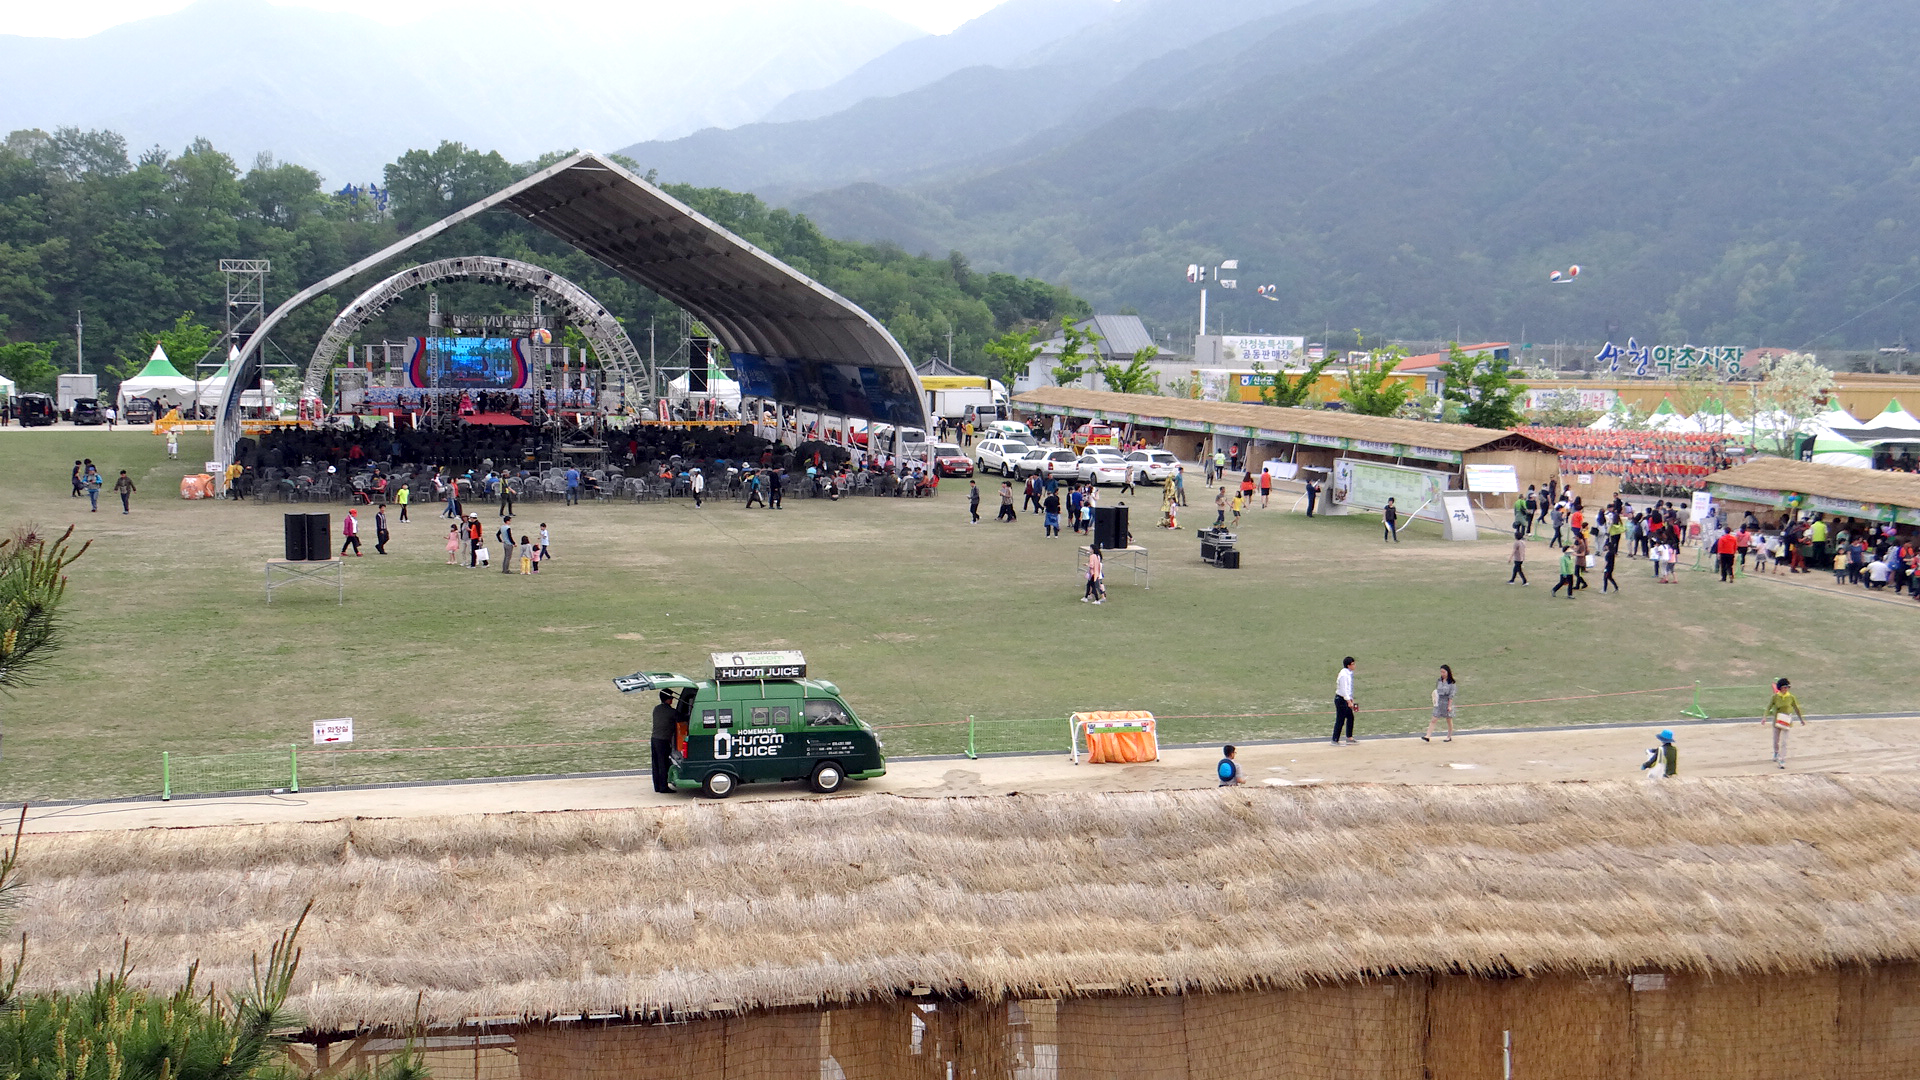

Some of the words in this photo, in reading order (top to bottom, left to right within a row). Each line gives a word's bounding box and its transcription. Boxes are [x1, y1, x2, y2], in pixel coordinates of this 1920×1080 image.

[1239, 339, 1294, 350] 산청농특산물
[1242, 349, 1290, 360] 공동판매장
[766, 667, 799, 676] JUICE
[737, 728, 777, 736] HOMEMADE
